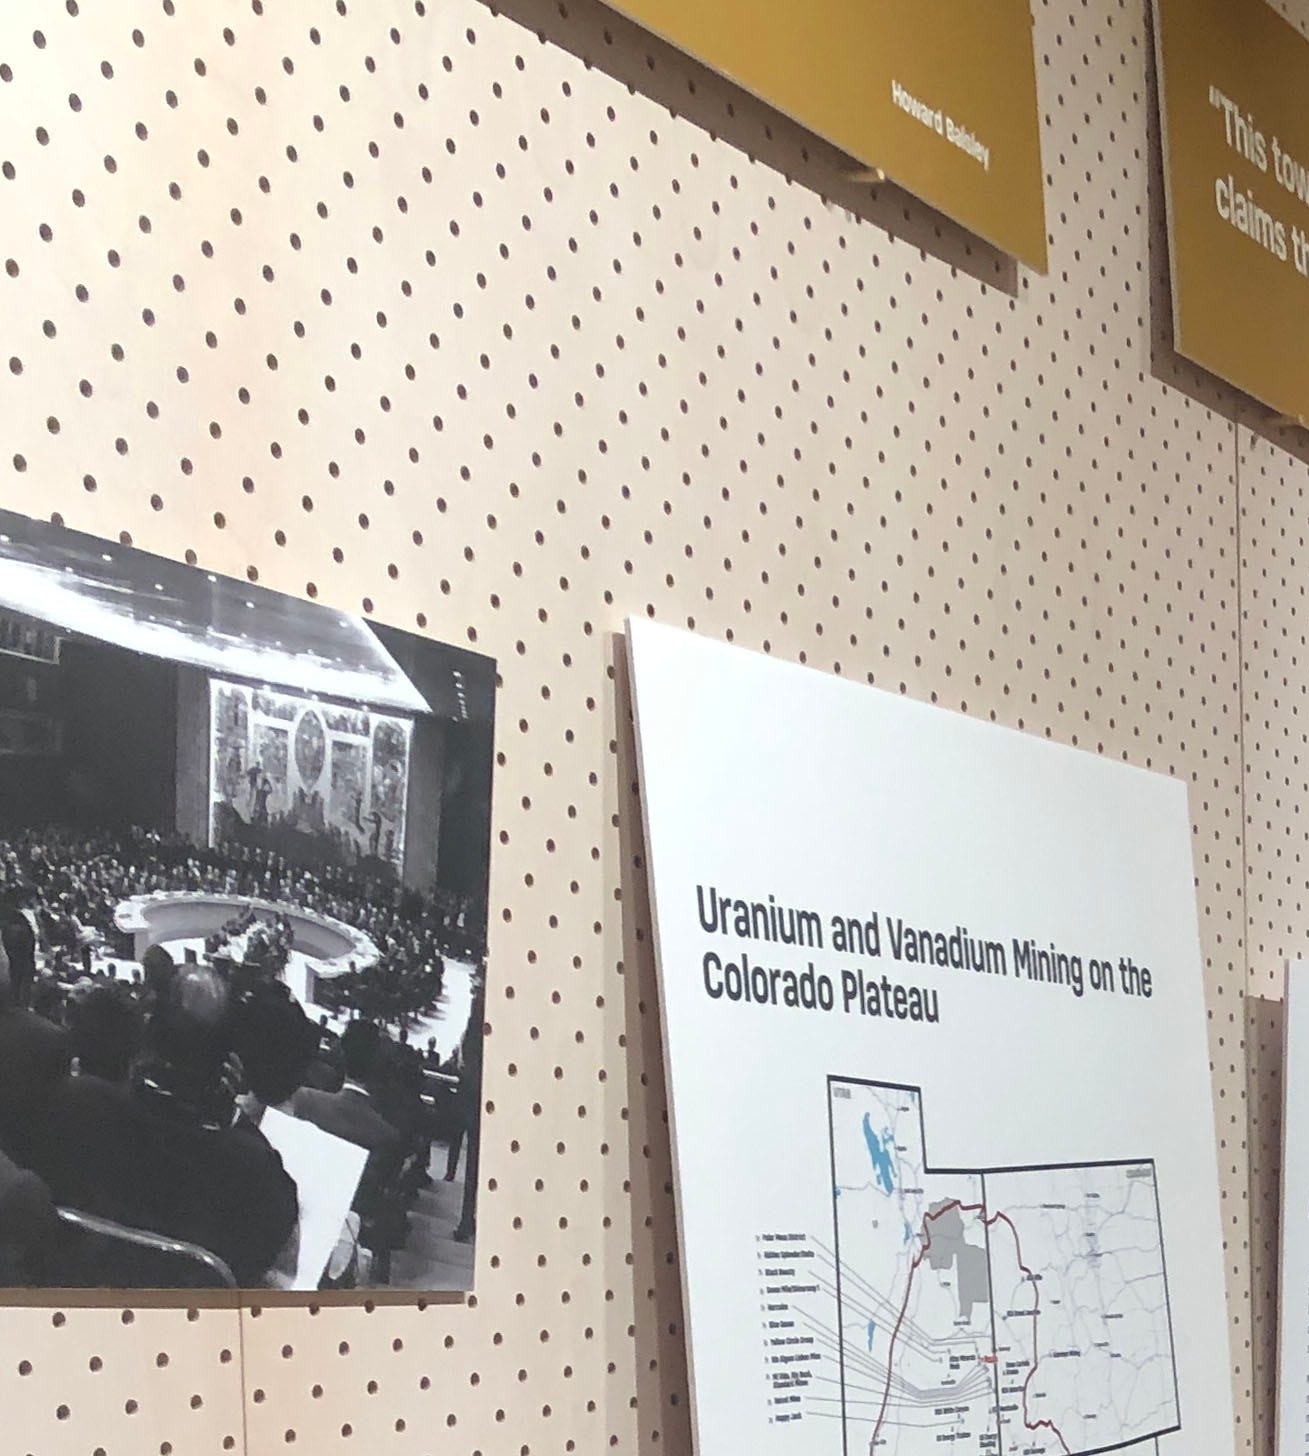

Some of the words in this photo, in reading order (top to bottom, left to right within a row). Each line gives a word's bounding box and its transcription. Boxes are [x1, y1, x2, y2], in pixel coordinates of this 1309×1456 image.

[892, 79, 943, 136] Howard
[946, 116, 989, 172] Balsley
[1215, 174, 1287, 261] claims
[697, 884, 824, 949] Uranium
[831, 911, 881, 957] and
[886, 916, 1007, 976] Vanadium
[1012, 938, 1084, 998] Mining
[1089, 958, 1115, 993] on
[1119, 957, 1153, 998] the
[703, 951, 834, 1011] Colorado
[841, 968, 940, 1023] Plateau
